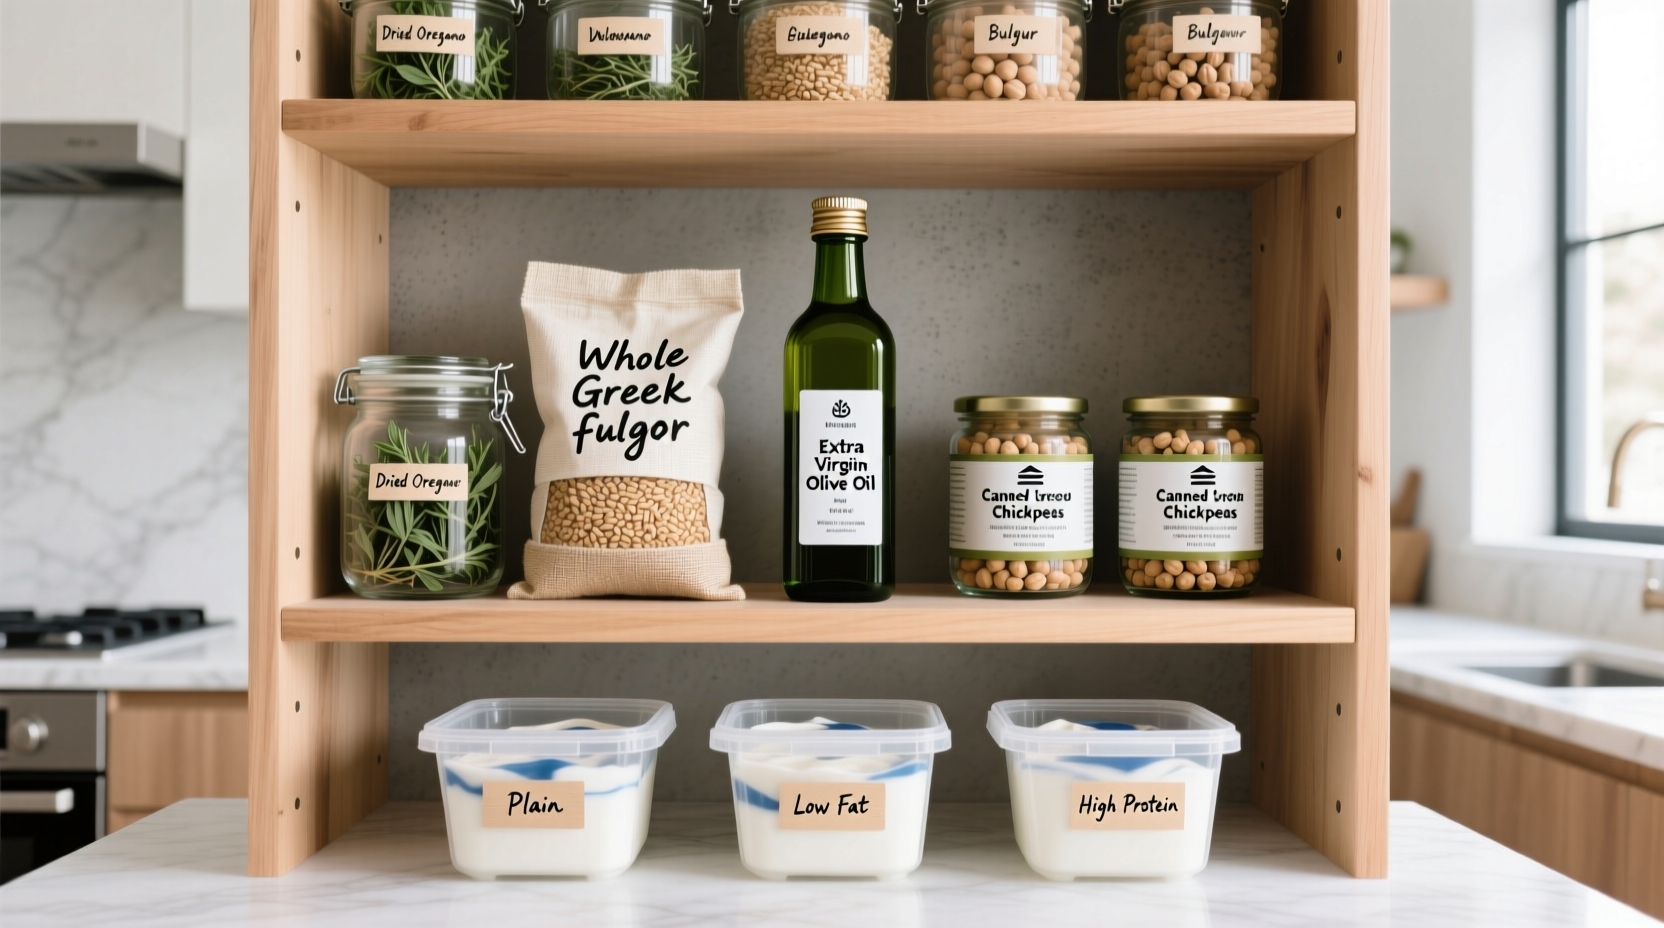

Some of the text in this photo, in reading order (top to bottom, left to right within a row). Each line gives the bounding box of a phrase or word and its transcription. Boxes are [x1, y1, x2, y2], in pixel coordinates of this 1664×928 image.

[382, 25, 412, 40] Dried
[989, 23, 1038, 47] Bulgur
[580, 339, 689, 371] Whole
[572, 373, 691, 408] Greek
[820, 439, 864, 454] Extra
[376, 473, 408, 488] Dried
[806, 475, 875, 490] Olive Oil
[1156, 489, 1208, 502] Canned
[1164, 504, 1237, 523] Chickpeas
[508, 791, 563, 816] Plain
[794, 794, 869, 815] Low Fat
[1079, 794, 1178, 822] High Protein
